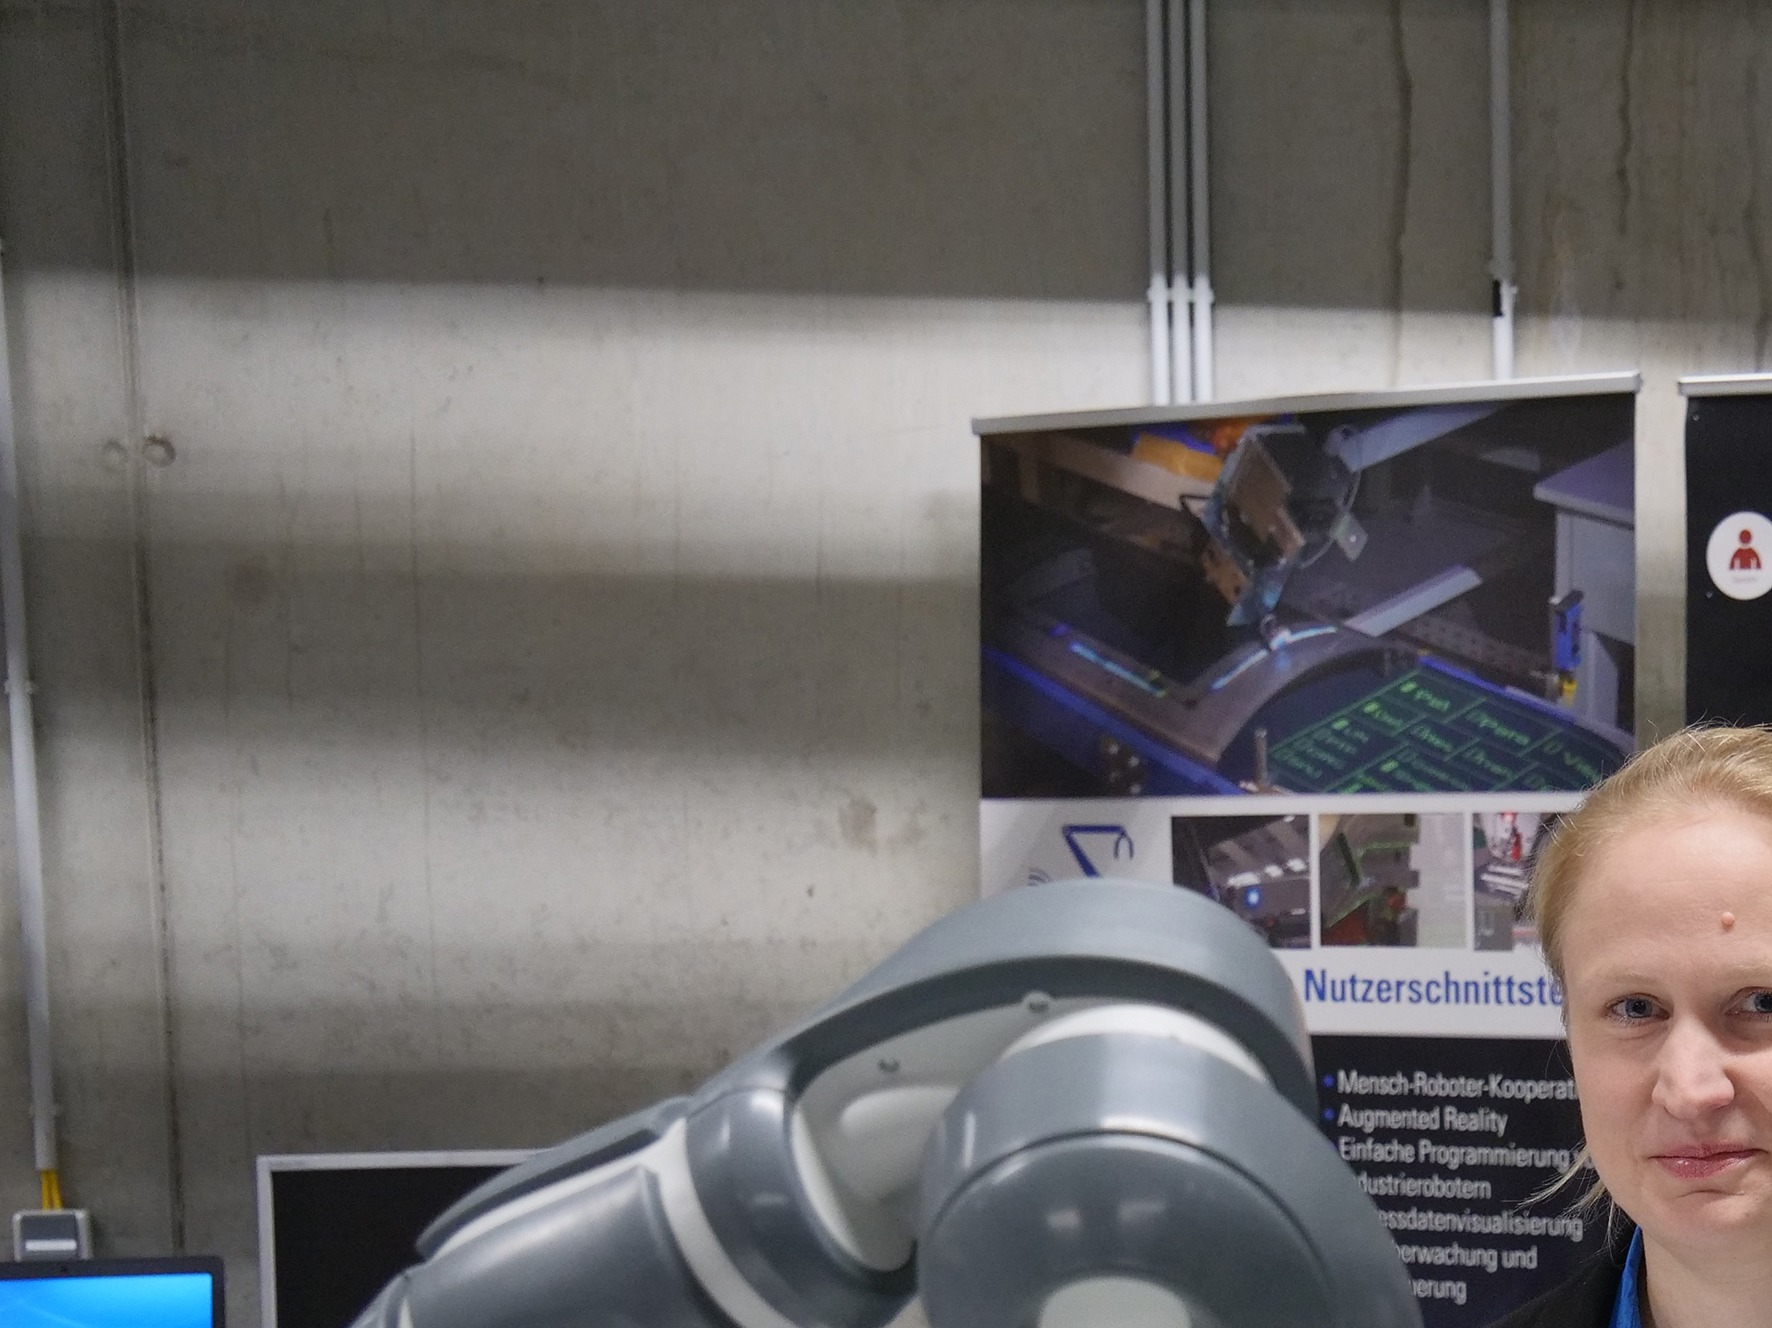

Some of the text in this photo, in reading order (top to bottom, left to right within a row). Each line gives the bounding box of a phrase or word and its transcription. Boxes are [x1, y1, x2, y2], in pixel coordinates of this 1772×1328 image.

[1337, 1103, 1509, 1137] Augmented Reality
[1338, 1135, 1415, 1164] Einfache
[1418, 1138, 1571, 1173] Programmierung
[1397, 1241, 1538, 1273] erwachung und
[1411, 1279, 1467, 1306] erung
